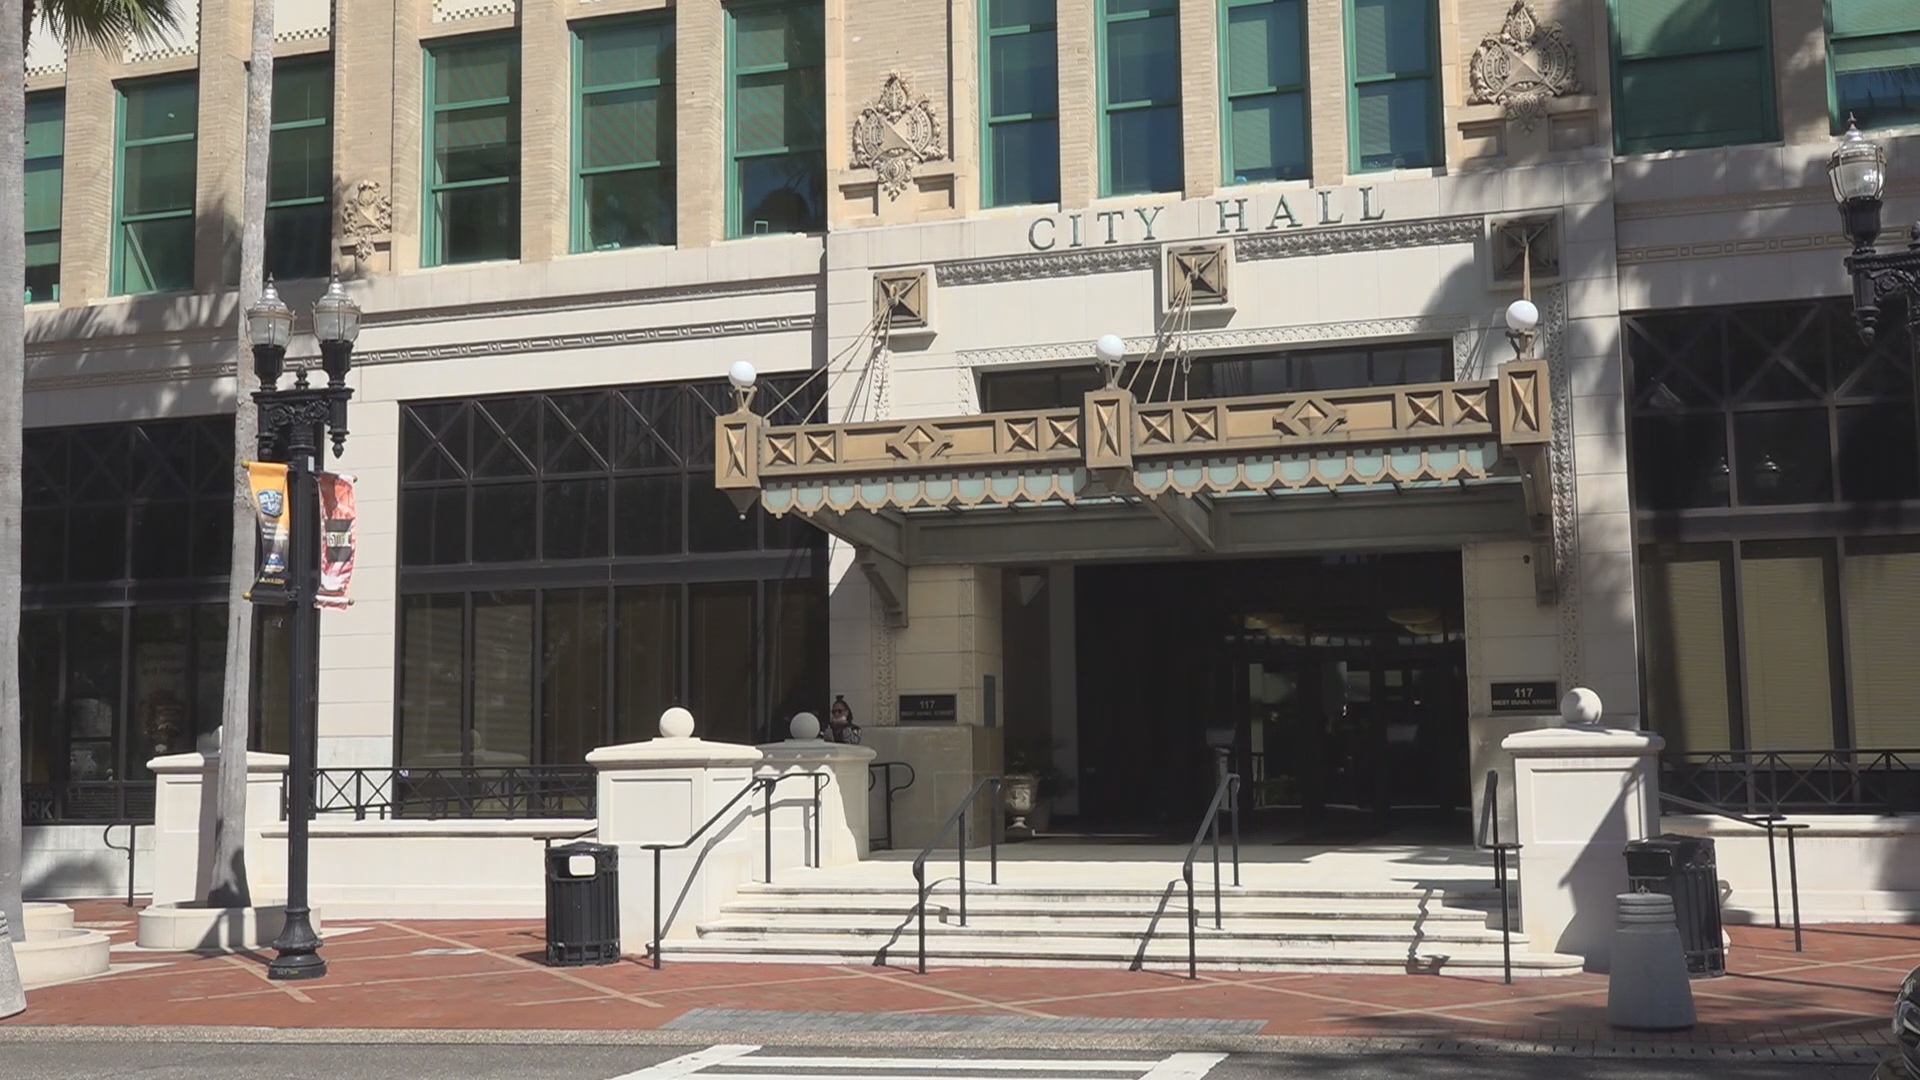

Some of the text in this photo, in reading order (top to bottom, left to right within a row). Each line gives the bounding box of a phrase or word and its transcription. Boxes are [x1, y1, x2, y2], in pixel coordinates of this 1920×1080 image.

[1028, 187, 1385, 251] CITY HALL
[1514, 687, 1534, 698] 117
[919, 699, 936, 710] 117
